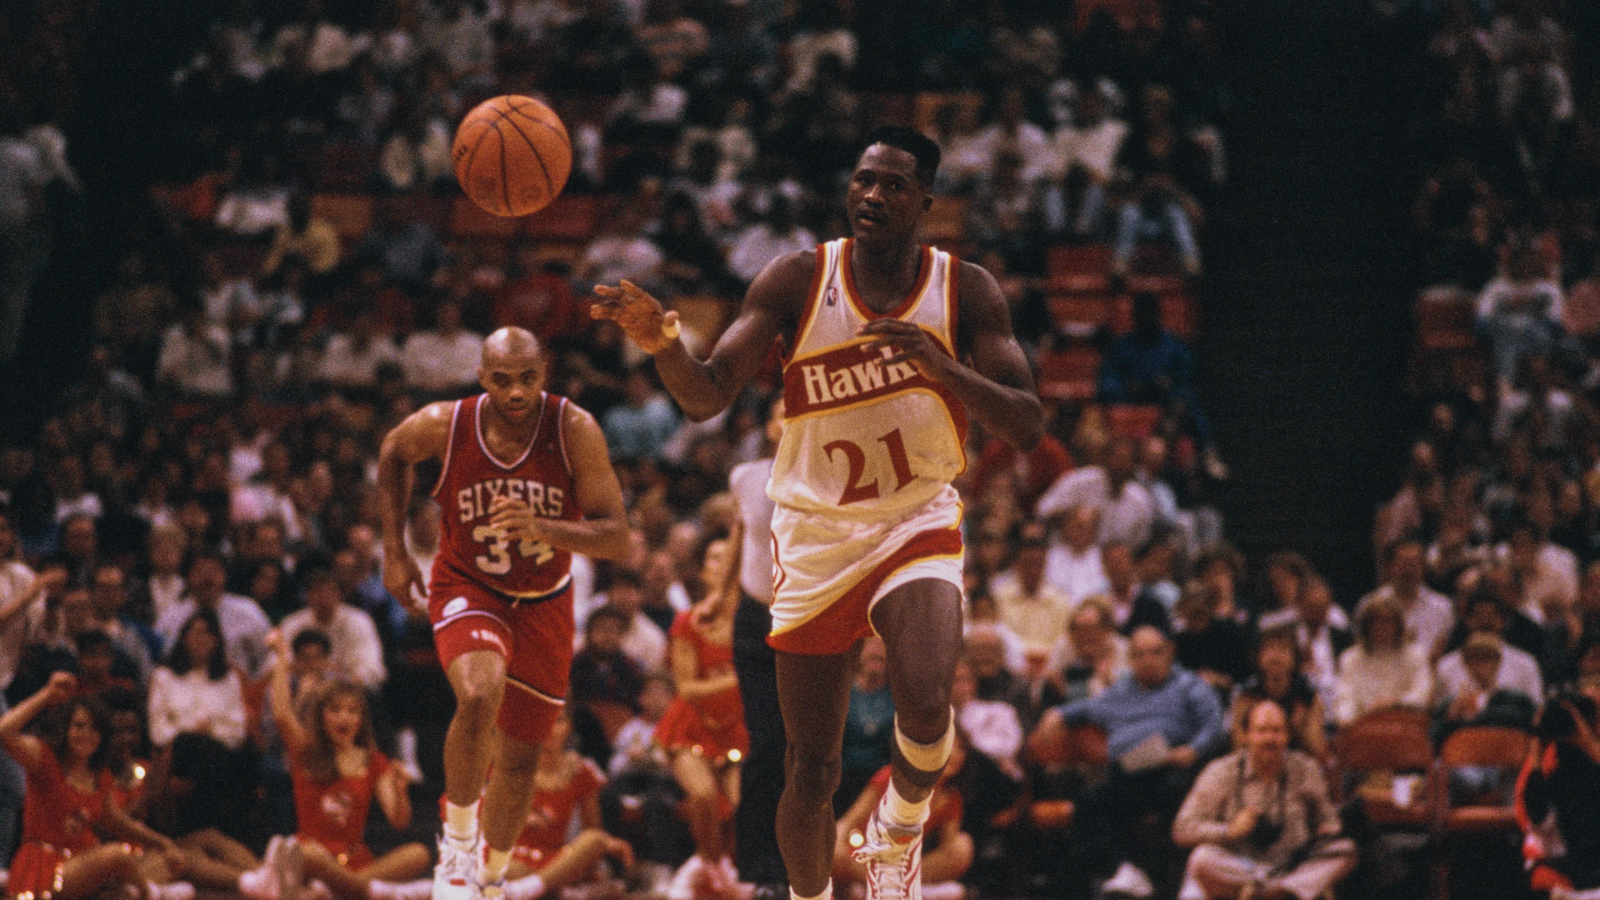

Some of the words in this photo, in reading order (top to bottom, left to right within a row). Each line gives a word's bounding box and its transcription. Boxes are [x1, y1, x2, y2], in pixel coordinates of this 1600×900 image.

[802, 345, 918, 404] Hawk
[823, 428, 918, 506] 21
[458, 479, 564, 523] SIXERS
[472, 525, 554, 575] 34
